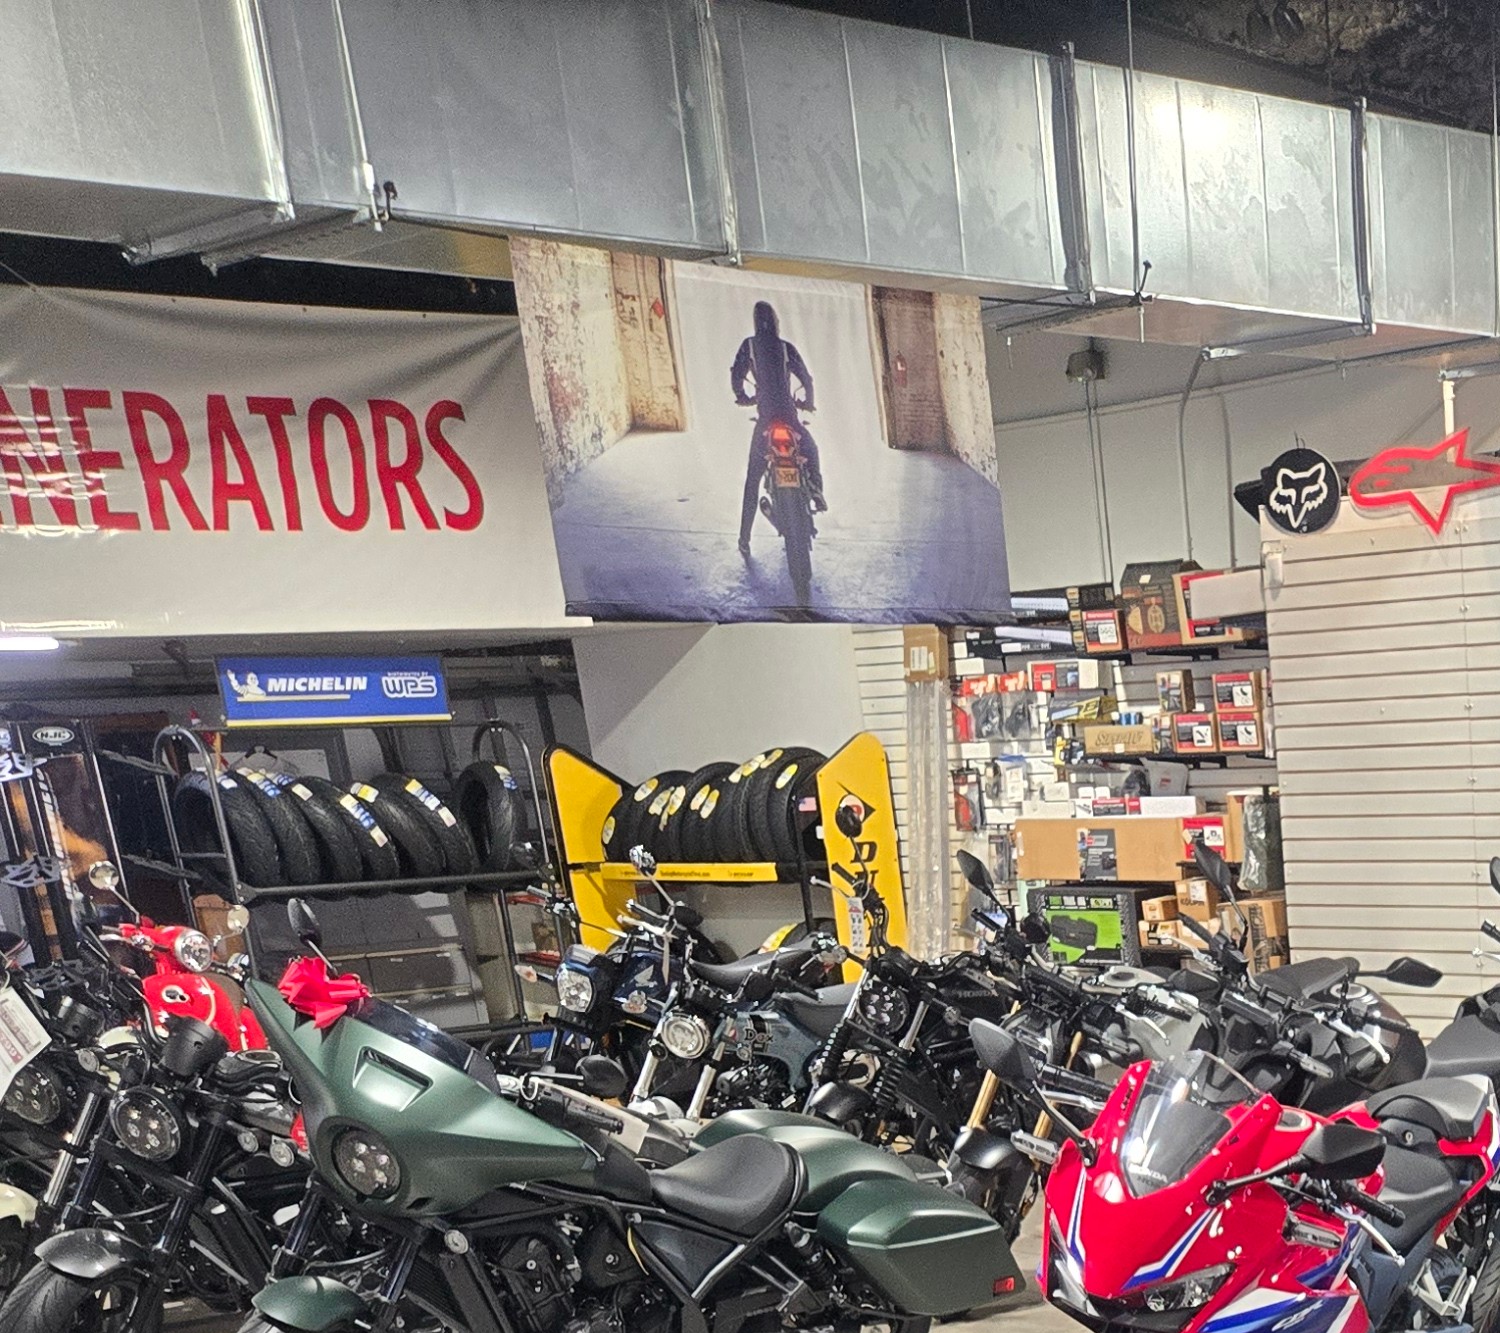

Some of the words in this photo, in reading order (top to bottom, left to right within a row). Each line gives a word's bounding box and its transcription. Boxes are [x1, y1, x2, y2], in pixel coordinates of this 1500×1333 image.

[0, 385, 484, 534] NERATORS
[268, 676, 368, 692] MICHELIN
[382, 675, 437, 698] WPS
